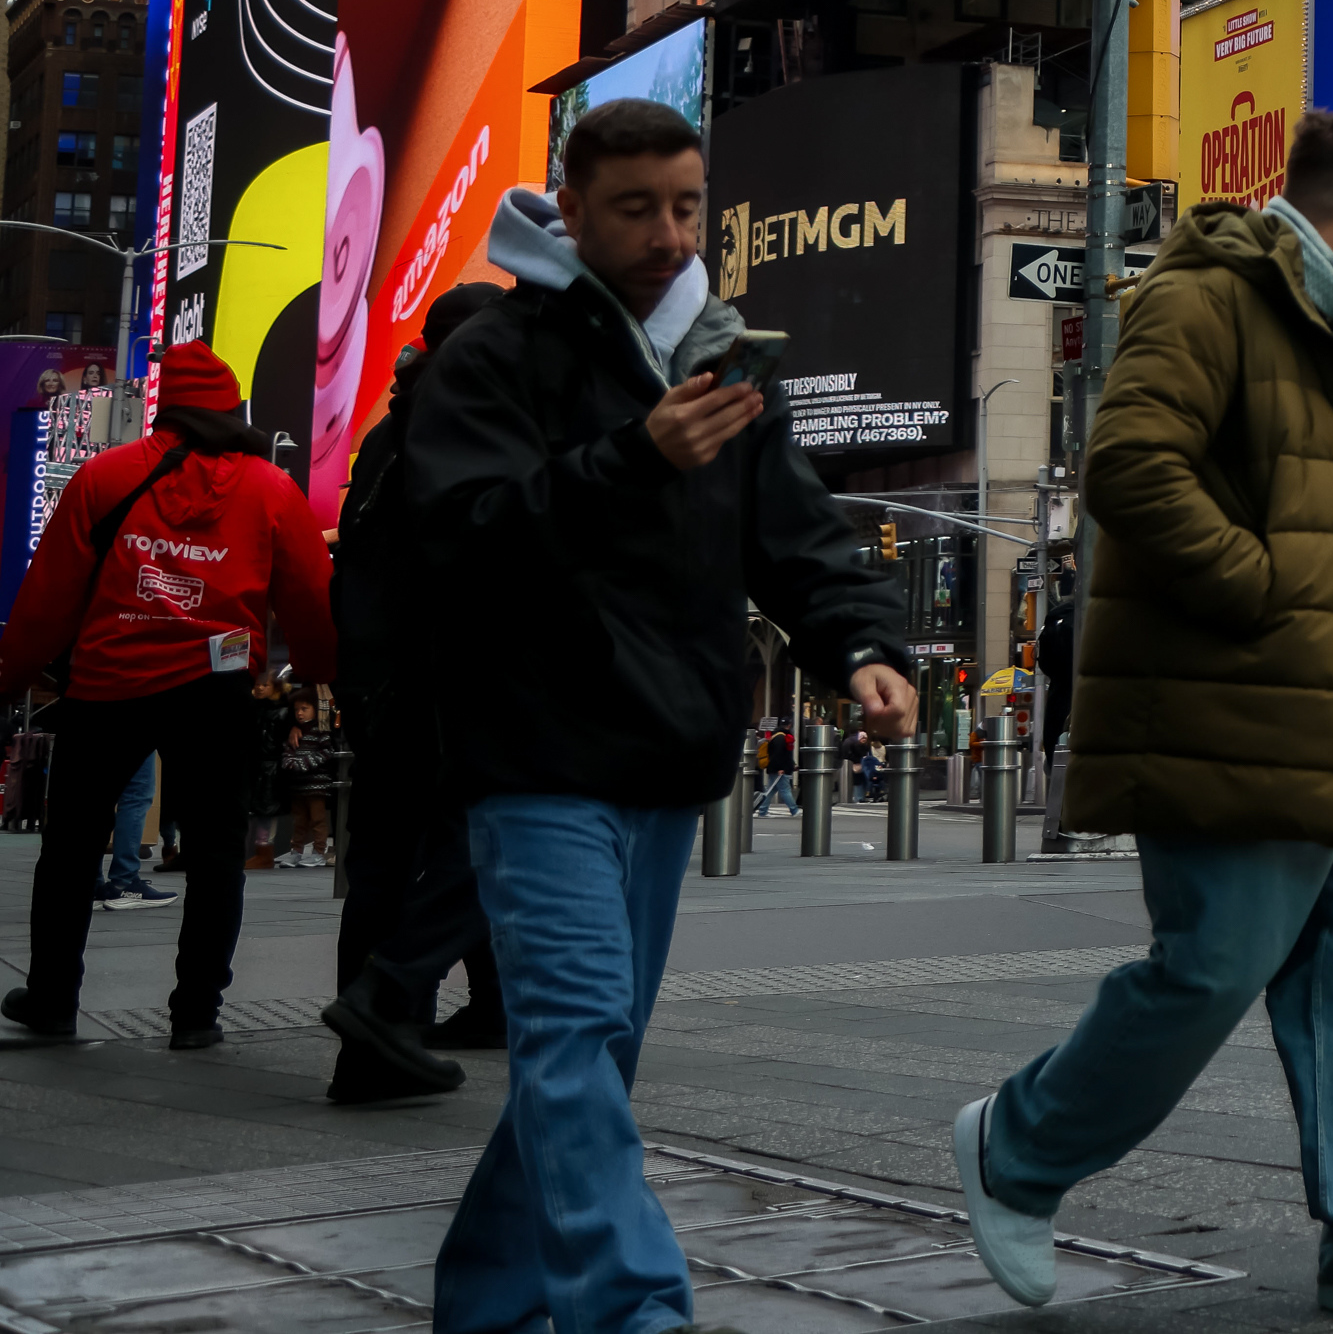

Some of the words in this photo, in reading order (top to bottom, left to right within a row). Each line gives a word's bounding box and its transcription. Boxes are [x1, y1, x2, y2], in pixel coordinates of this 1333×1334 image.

[1228, 18, 1242, 32] LITTLE
[1242, 12, 1257, 26] SHOW
[1216, 38, 1234, 58] VERY
[1234, 34, 1246, 52] BIG
[1247, 24, 1272, 47] FUTURE
[1201, 107, 1285, 194] OPERATION
[391, 124, 490, 323] amazon
[1032, 210, 1078, 231] THE
[1132, 205, 1150, 227] WAY
[752, 198, 907, 266] BETMGM
[1037, 263, 1083, 286] ONE
[1064, 323, 1074, 334] NO
[793, 372, 858, 396] RESPONSIBLY
[875, 403, 903, 412] PRESENT
[922, 400, 942, 410] ONLY.
[792, 415, 859, 434] GAMBLING
[861, 410, 950, 429] PROBLEM?
[800, 430, 853, 447] HOPENY
[857, 426, 927, 445] (467369).
[29, 450, 48, 551] OUTDOOR
